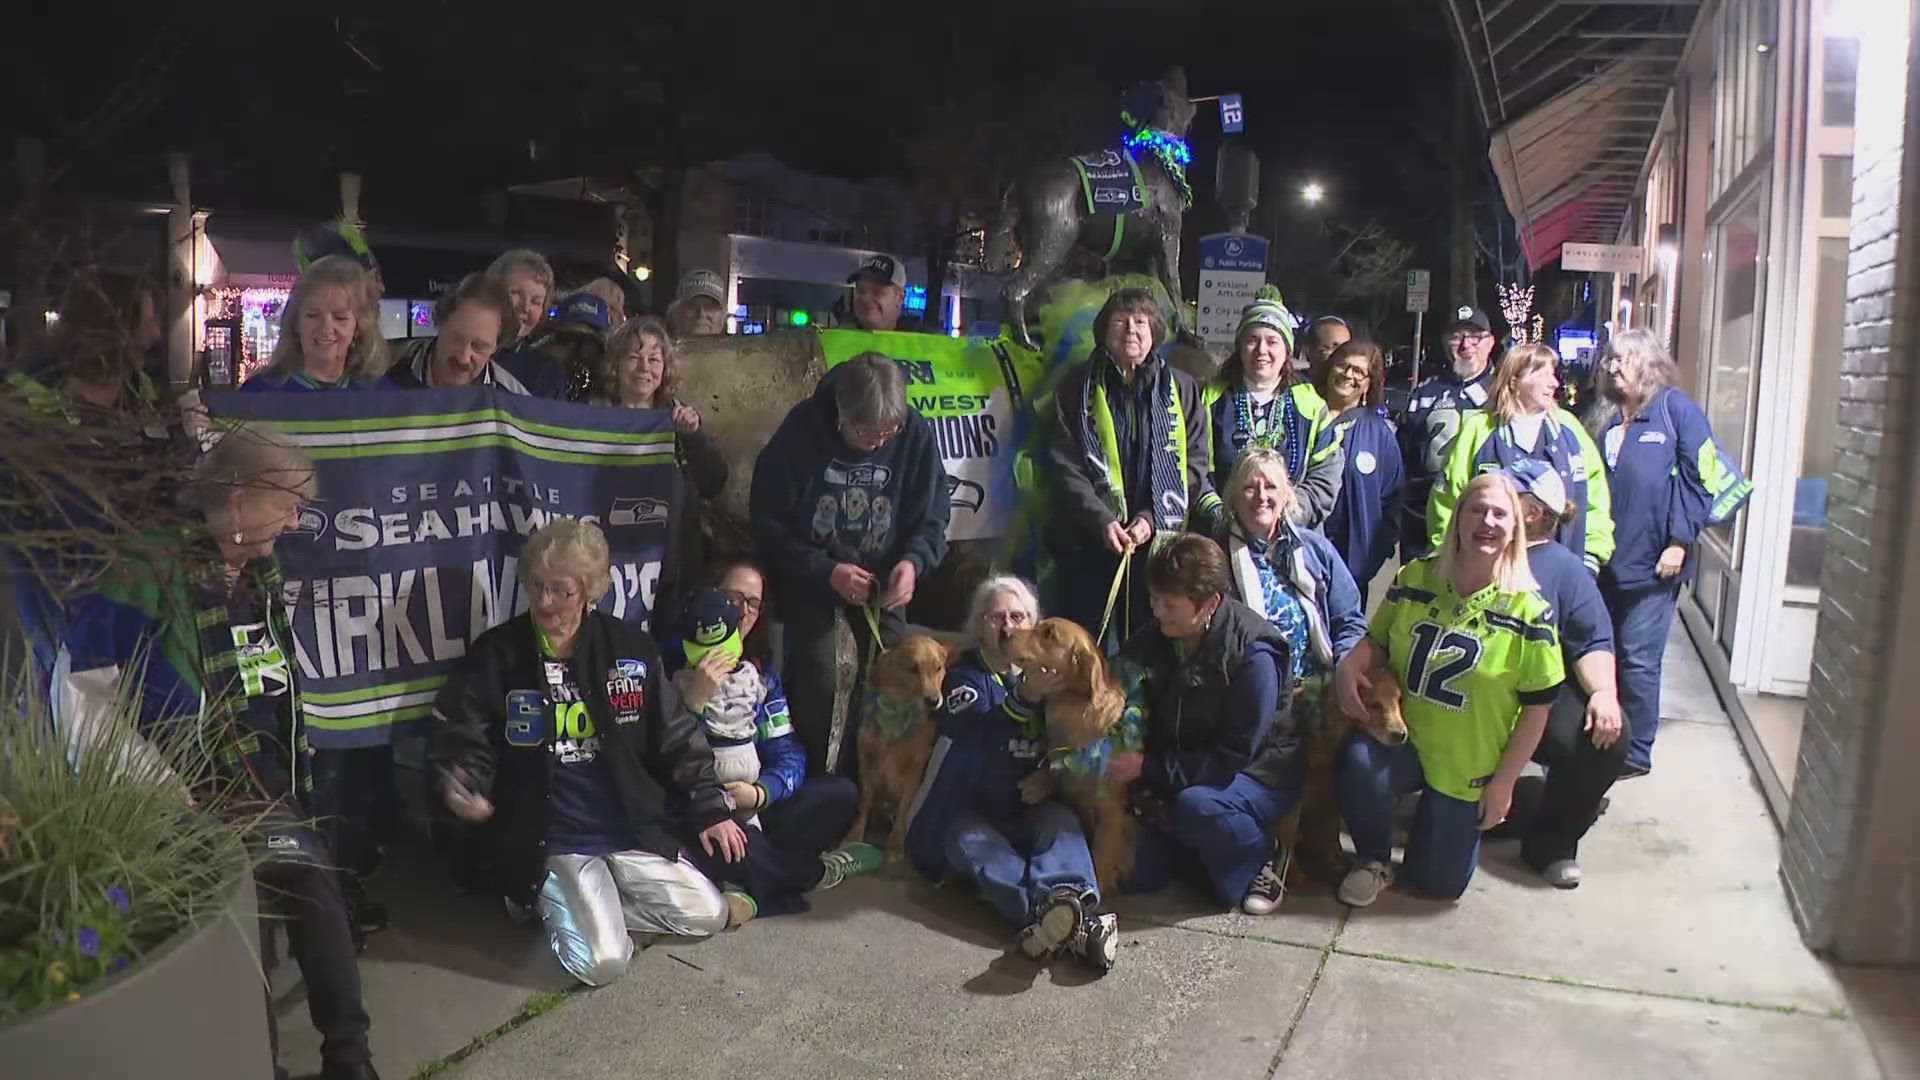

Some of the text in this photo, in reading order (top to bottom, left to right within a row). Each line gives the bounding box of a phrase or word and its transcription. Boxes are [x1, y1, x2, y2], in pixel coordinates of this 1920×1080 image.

[1223, 101, 1241, 125] 12
[1217, 280, 1248, 289] Kirkland
[1217, 289, 1234, 298] Arts
[1215, 307, 1232, 317] City
[912, 395, 989, 411] WEST
[929, 414, 999, 459] IONS
[335, 500, 601, 551] SEAHAW
[283, 556, 662, 679] KIRKLA'S
[1406, 622, 1484, 712] 12
[606, 677, 634, 696] FAN
[609, 692, 643, 710] YEAR
